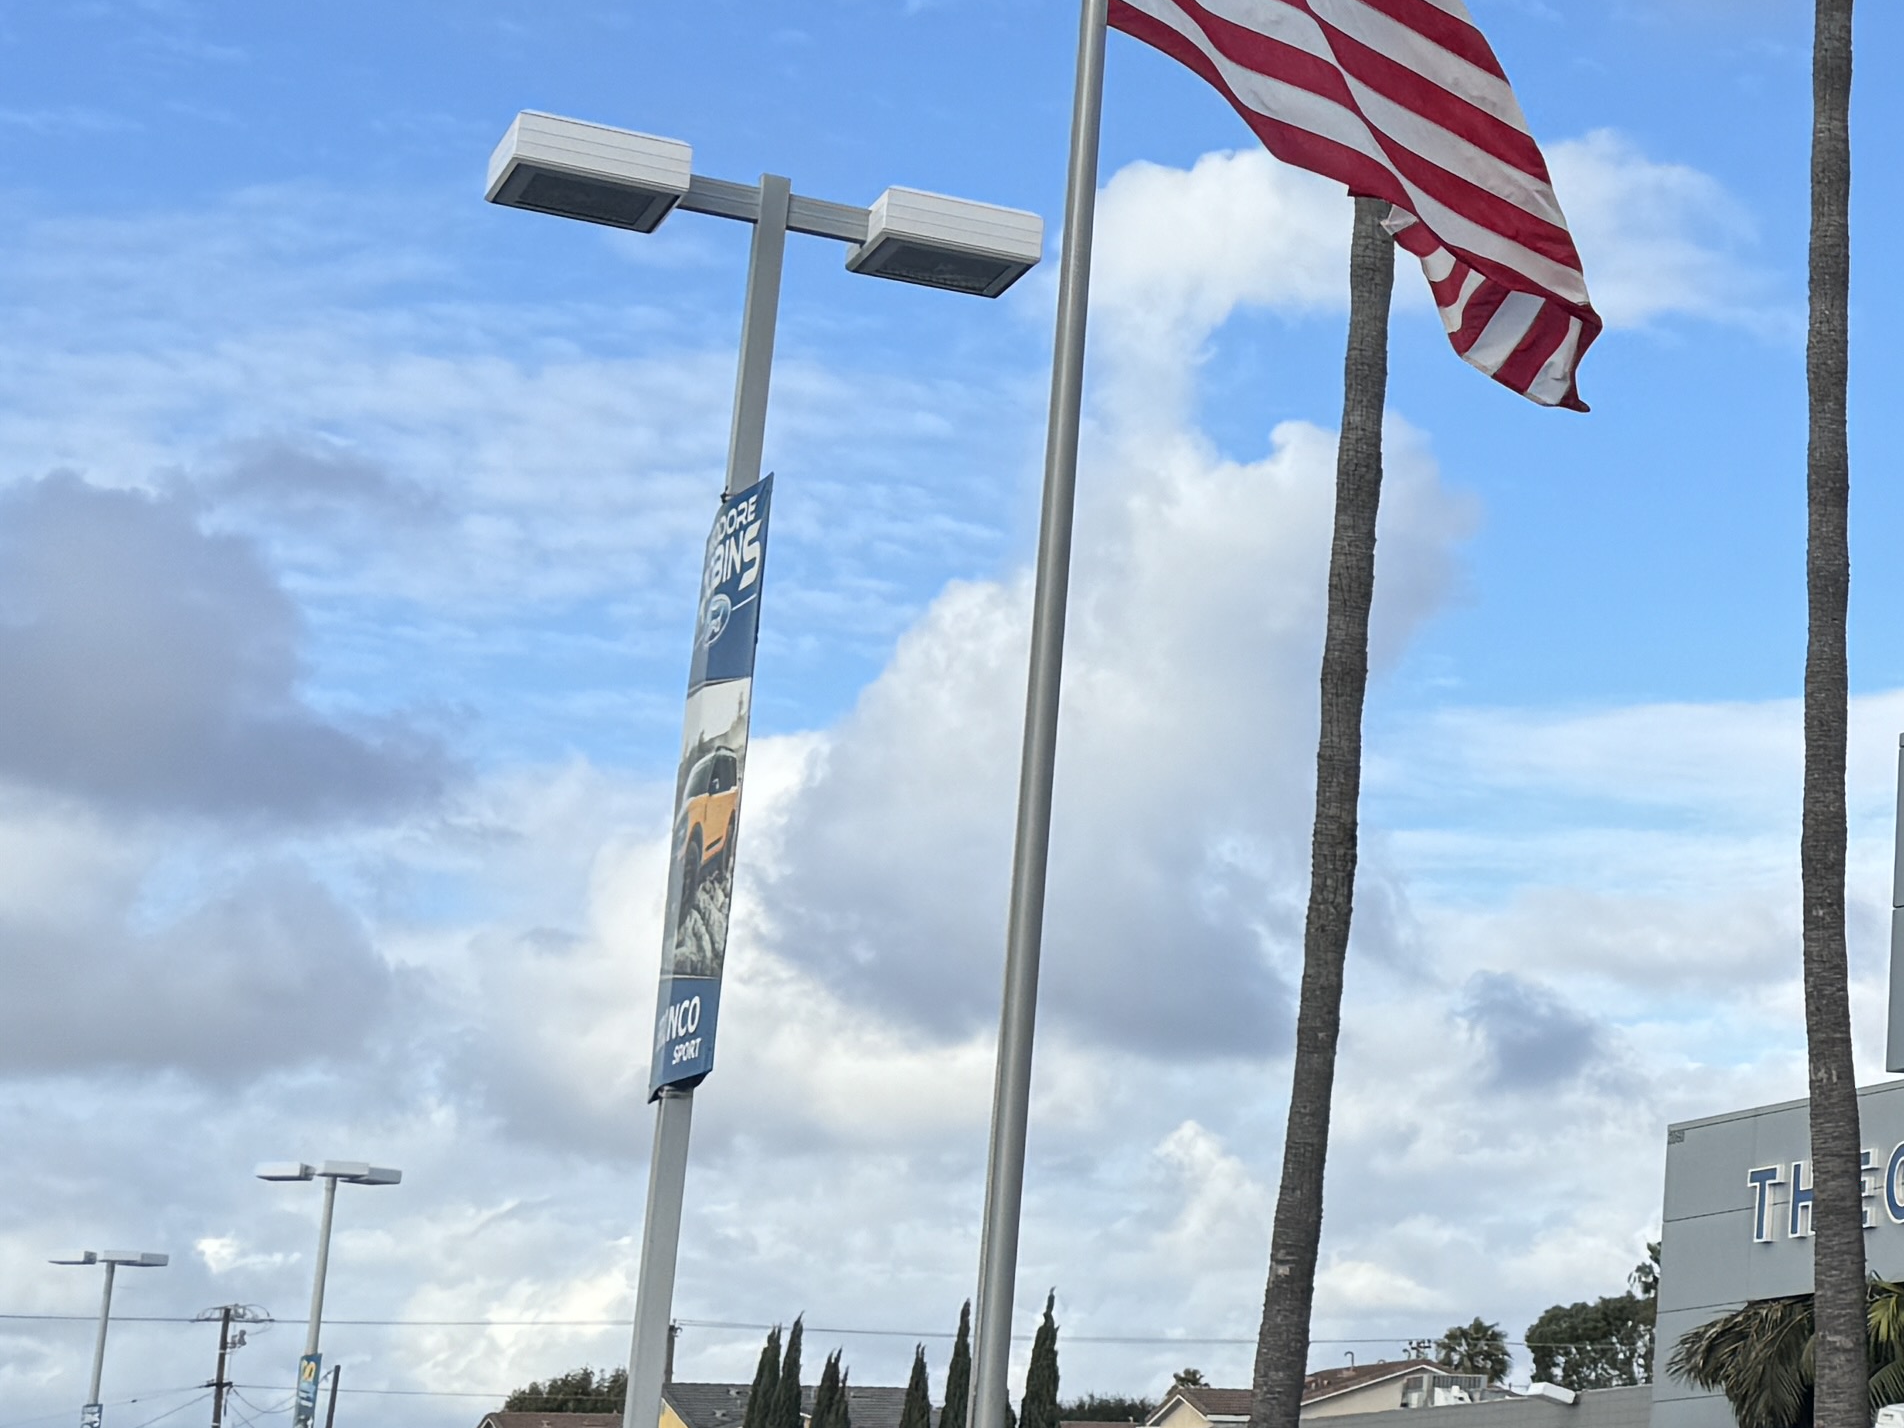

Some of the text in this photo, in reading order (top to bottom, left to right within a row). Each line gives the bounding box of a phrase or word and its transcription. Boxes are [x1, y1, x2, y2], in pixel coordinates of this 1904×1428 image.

[711, 493, 758, 546] DORE
[705, 518, 762, 596] BINS
[672, 1037, 702, 1065] SPORT
